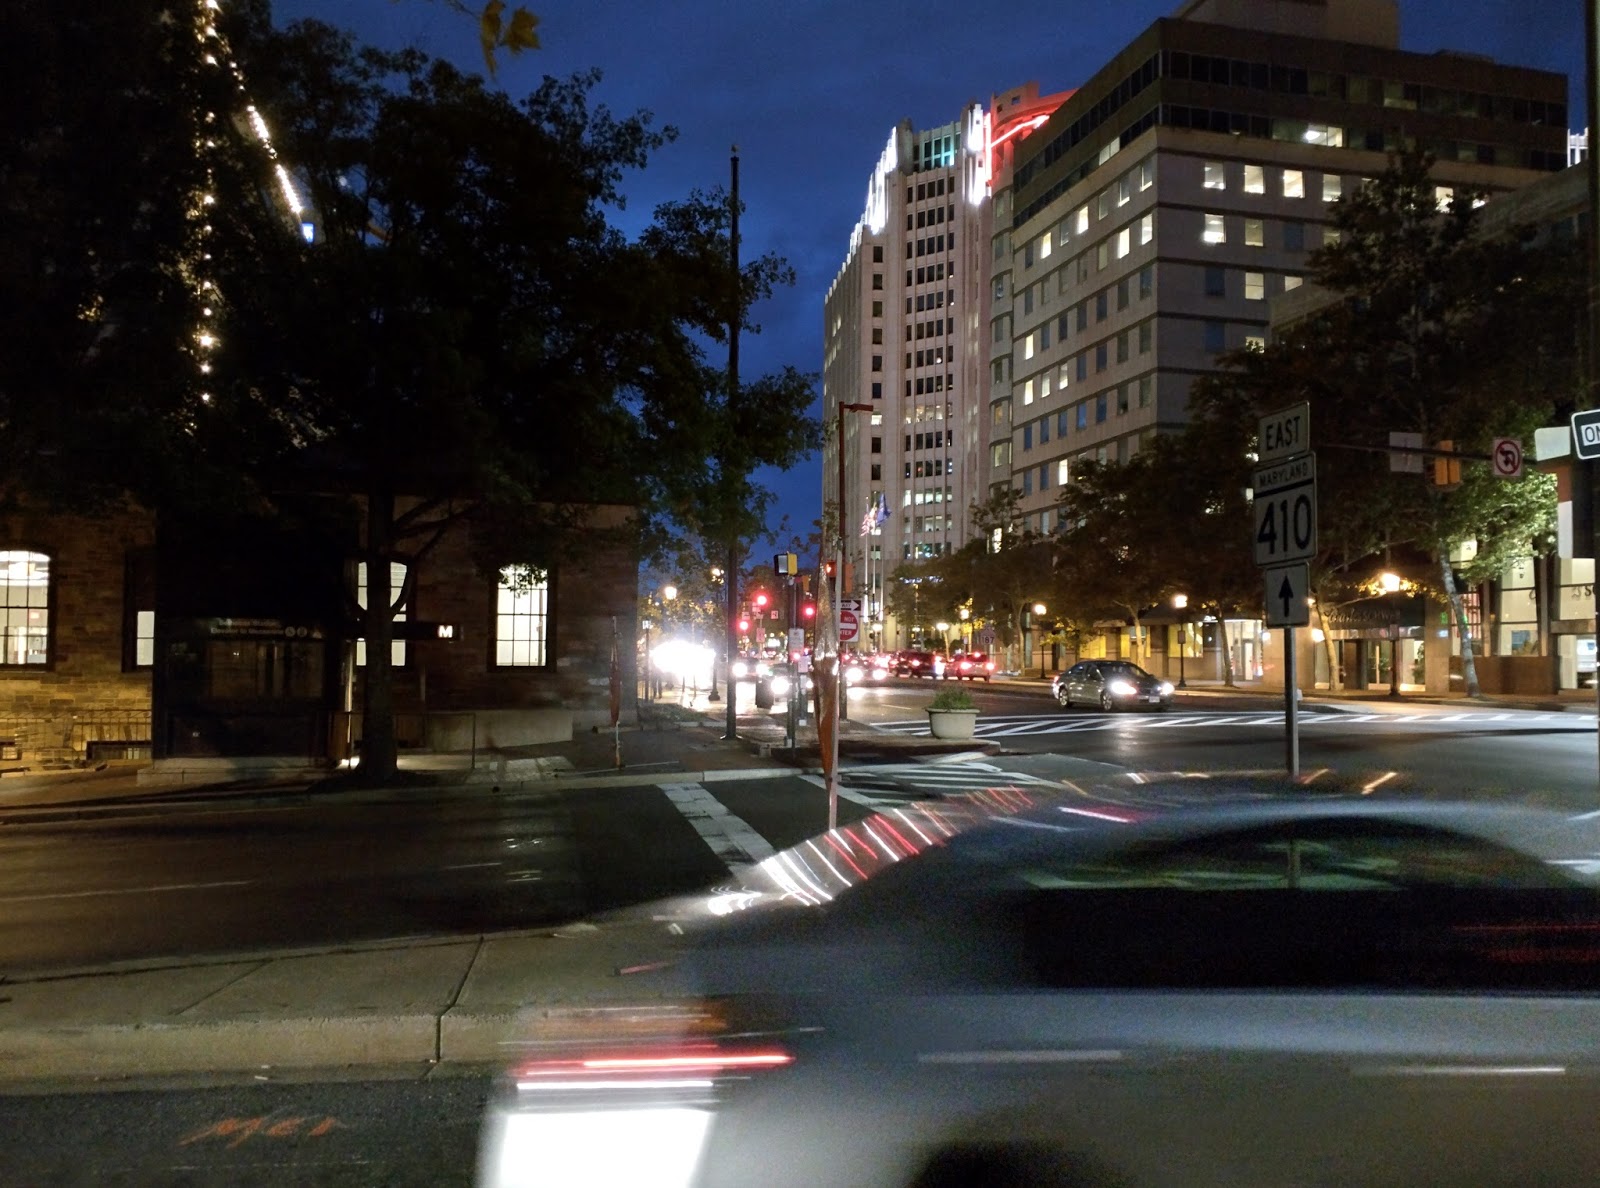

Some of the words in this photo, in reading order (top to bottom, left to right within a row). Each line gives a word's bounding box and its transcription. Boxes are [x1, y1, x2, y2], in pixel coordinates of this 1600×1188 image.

[1265, 415, 1301, 451] EAST
[1259, 461, 1308, 486] MARYLAND
[1257, 493, 1312, 555] 410
[438, 624, 453, 638] M
[982, 636, 995, 645] 187
